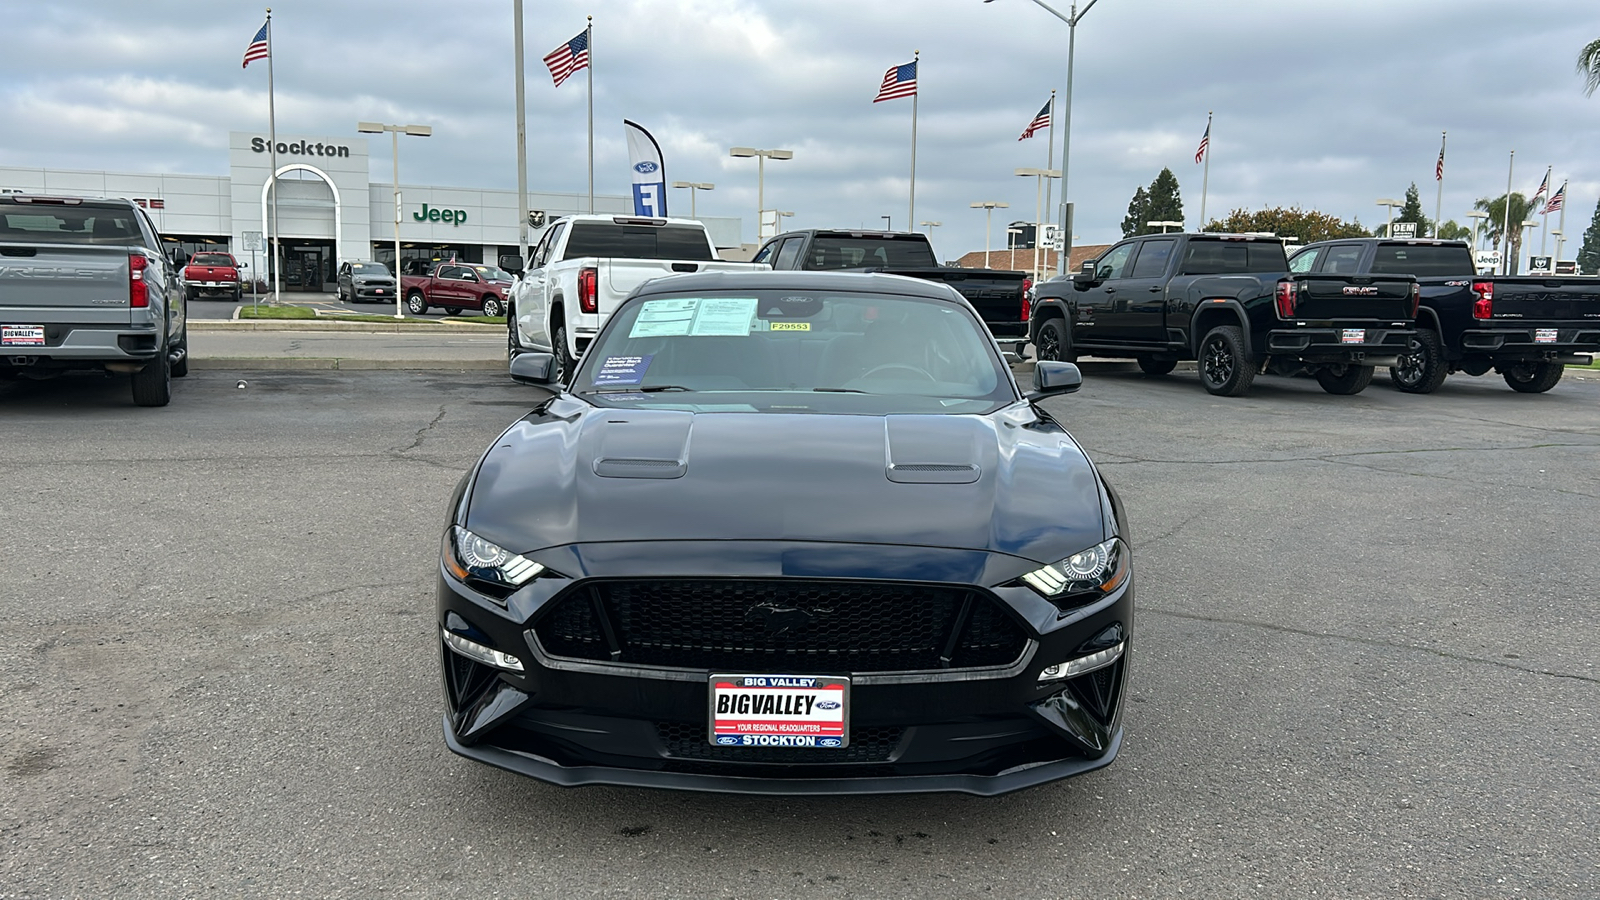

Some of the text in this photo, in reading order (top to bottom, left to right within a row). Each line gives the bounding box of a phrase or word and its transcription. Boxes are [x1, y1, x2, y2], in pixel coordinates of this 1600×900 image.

[251, 137, 349, 158] Stockton
[413, 203, 467, 226] Jeep
[1393, 224, 1415, 232] OEM
[1478, 255, 1499, 264] Jeep
[1342, 286, 1378, 295] GMC
[1502, 293, 1599, 301] CHEVROLET
[744, 678, 816, 687] BIG VALLEY
[716, 694, 816, 715] BIGVALLEY
[737, 723, 820, 732] YOUR REGIONAL HEADQUARTERS
[742, 735, 816, 746] STOCKTON
